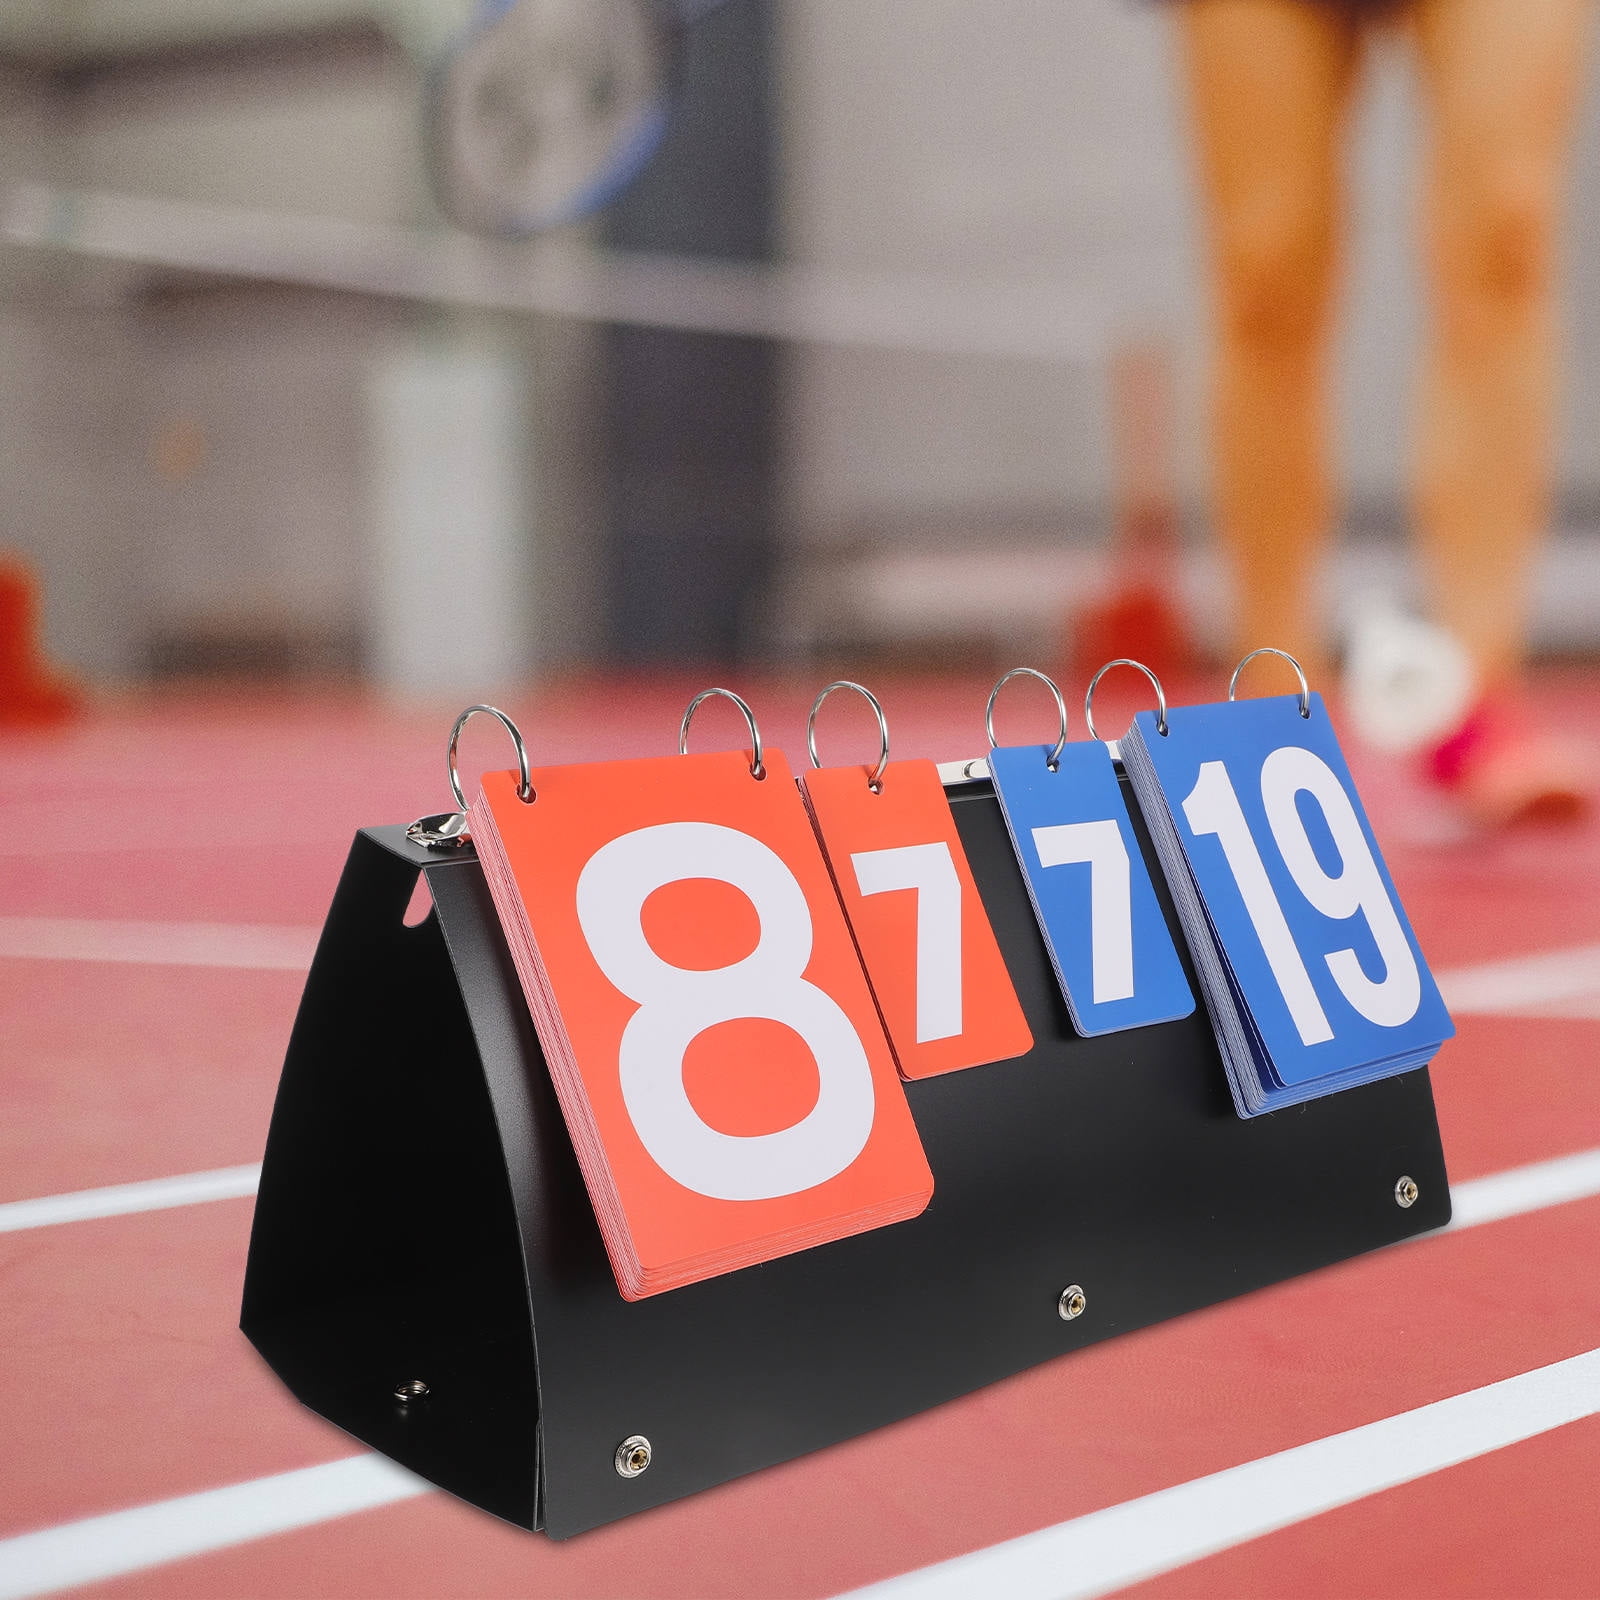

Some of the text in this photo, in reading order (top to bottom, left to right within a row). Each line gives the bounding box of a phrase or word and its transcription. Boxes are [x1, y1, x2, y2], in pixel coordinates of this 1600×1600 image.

[576, 822, 875, 1201] 8
[850, 841, 963, 1044] 7
[1031, 819, 1134, 1005] 7
[1181, 746, 1421, 1047] 19
